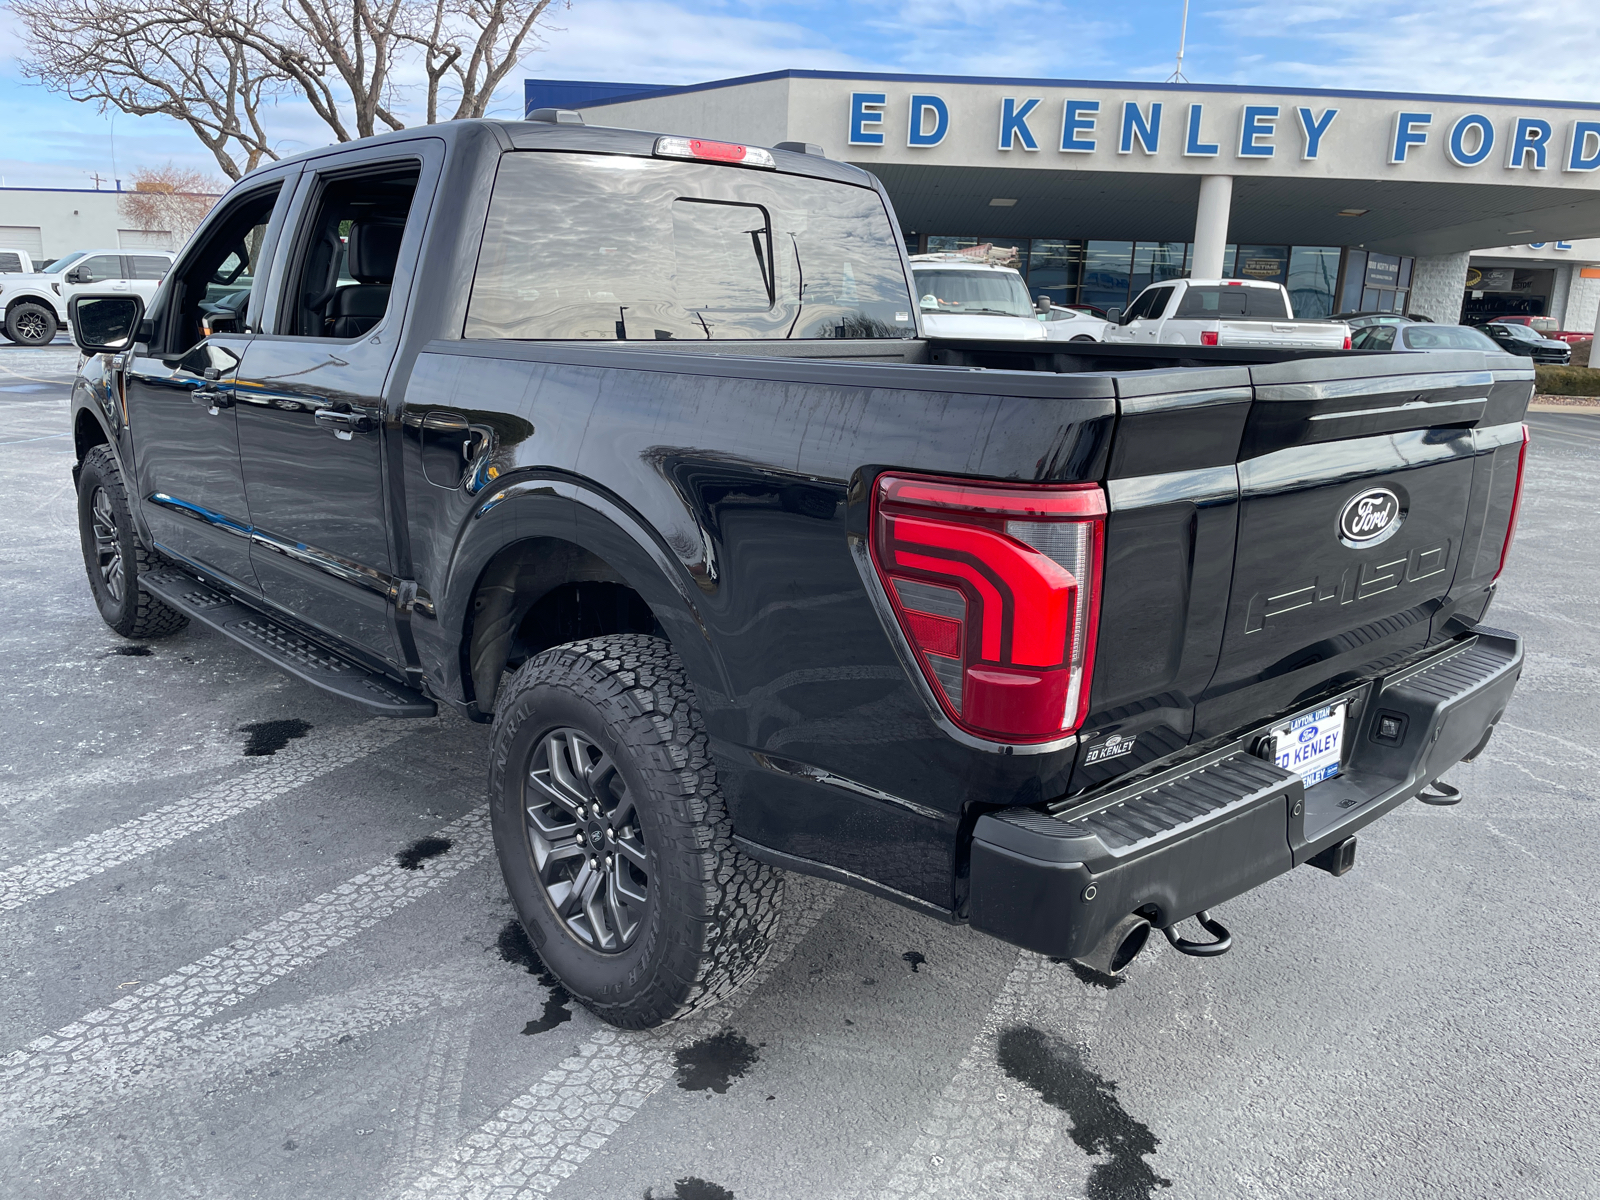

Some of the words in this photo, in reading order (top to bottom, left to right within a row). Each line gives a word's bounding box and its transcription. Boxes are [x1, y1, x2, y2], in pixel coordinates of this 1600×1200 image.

[849, 92, 950, 146] ED
[999, 98, 1338, 160] KENLEY
[1391, 111, 1600, 171] FORD
[1352, 496, 1391, 534] Ford
[1245, 538, 1452, 635] F-150
[910, 600, 961, 615] FORD
[1315, 706, 1331, 720] UTAH
[494, 702, 537, 813] GENERAL
[1086, 750, 1099, 762] ED
[1100, 740, 1135, 759] KENLEY
[1294, 731, 1339, 765] KENLEY
[1302, 768, 1326, 788] ENLEY
